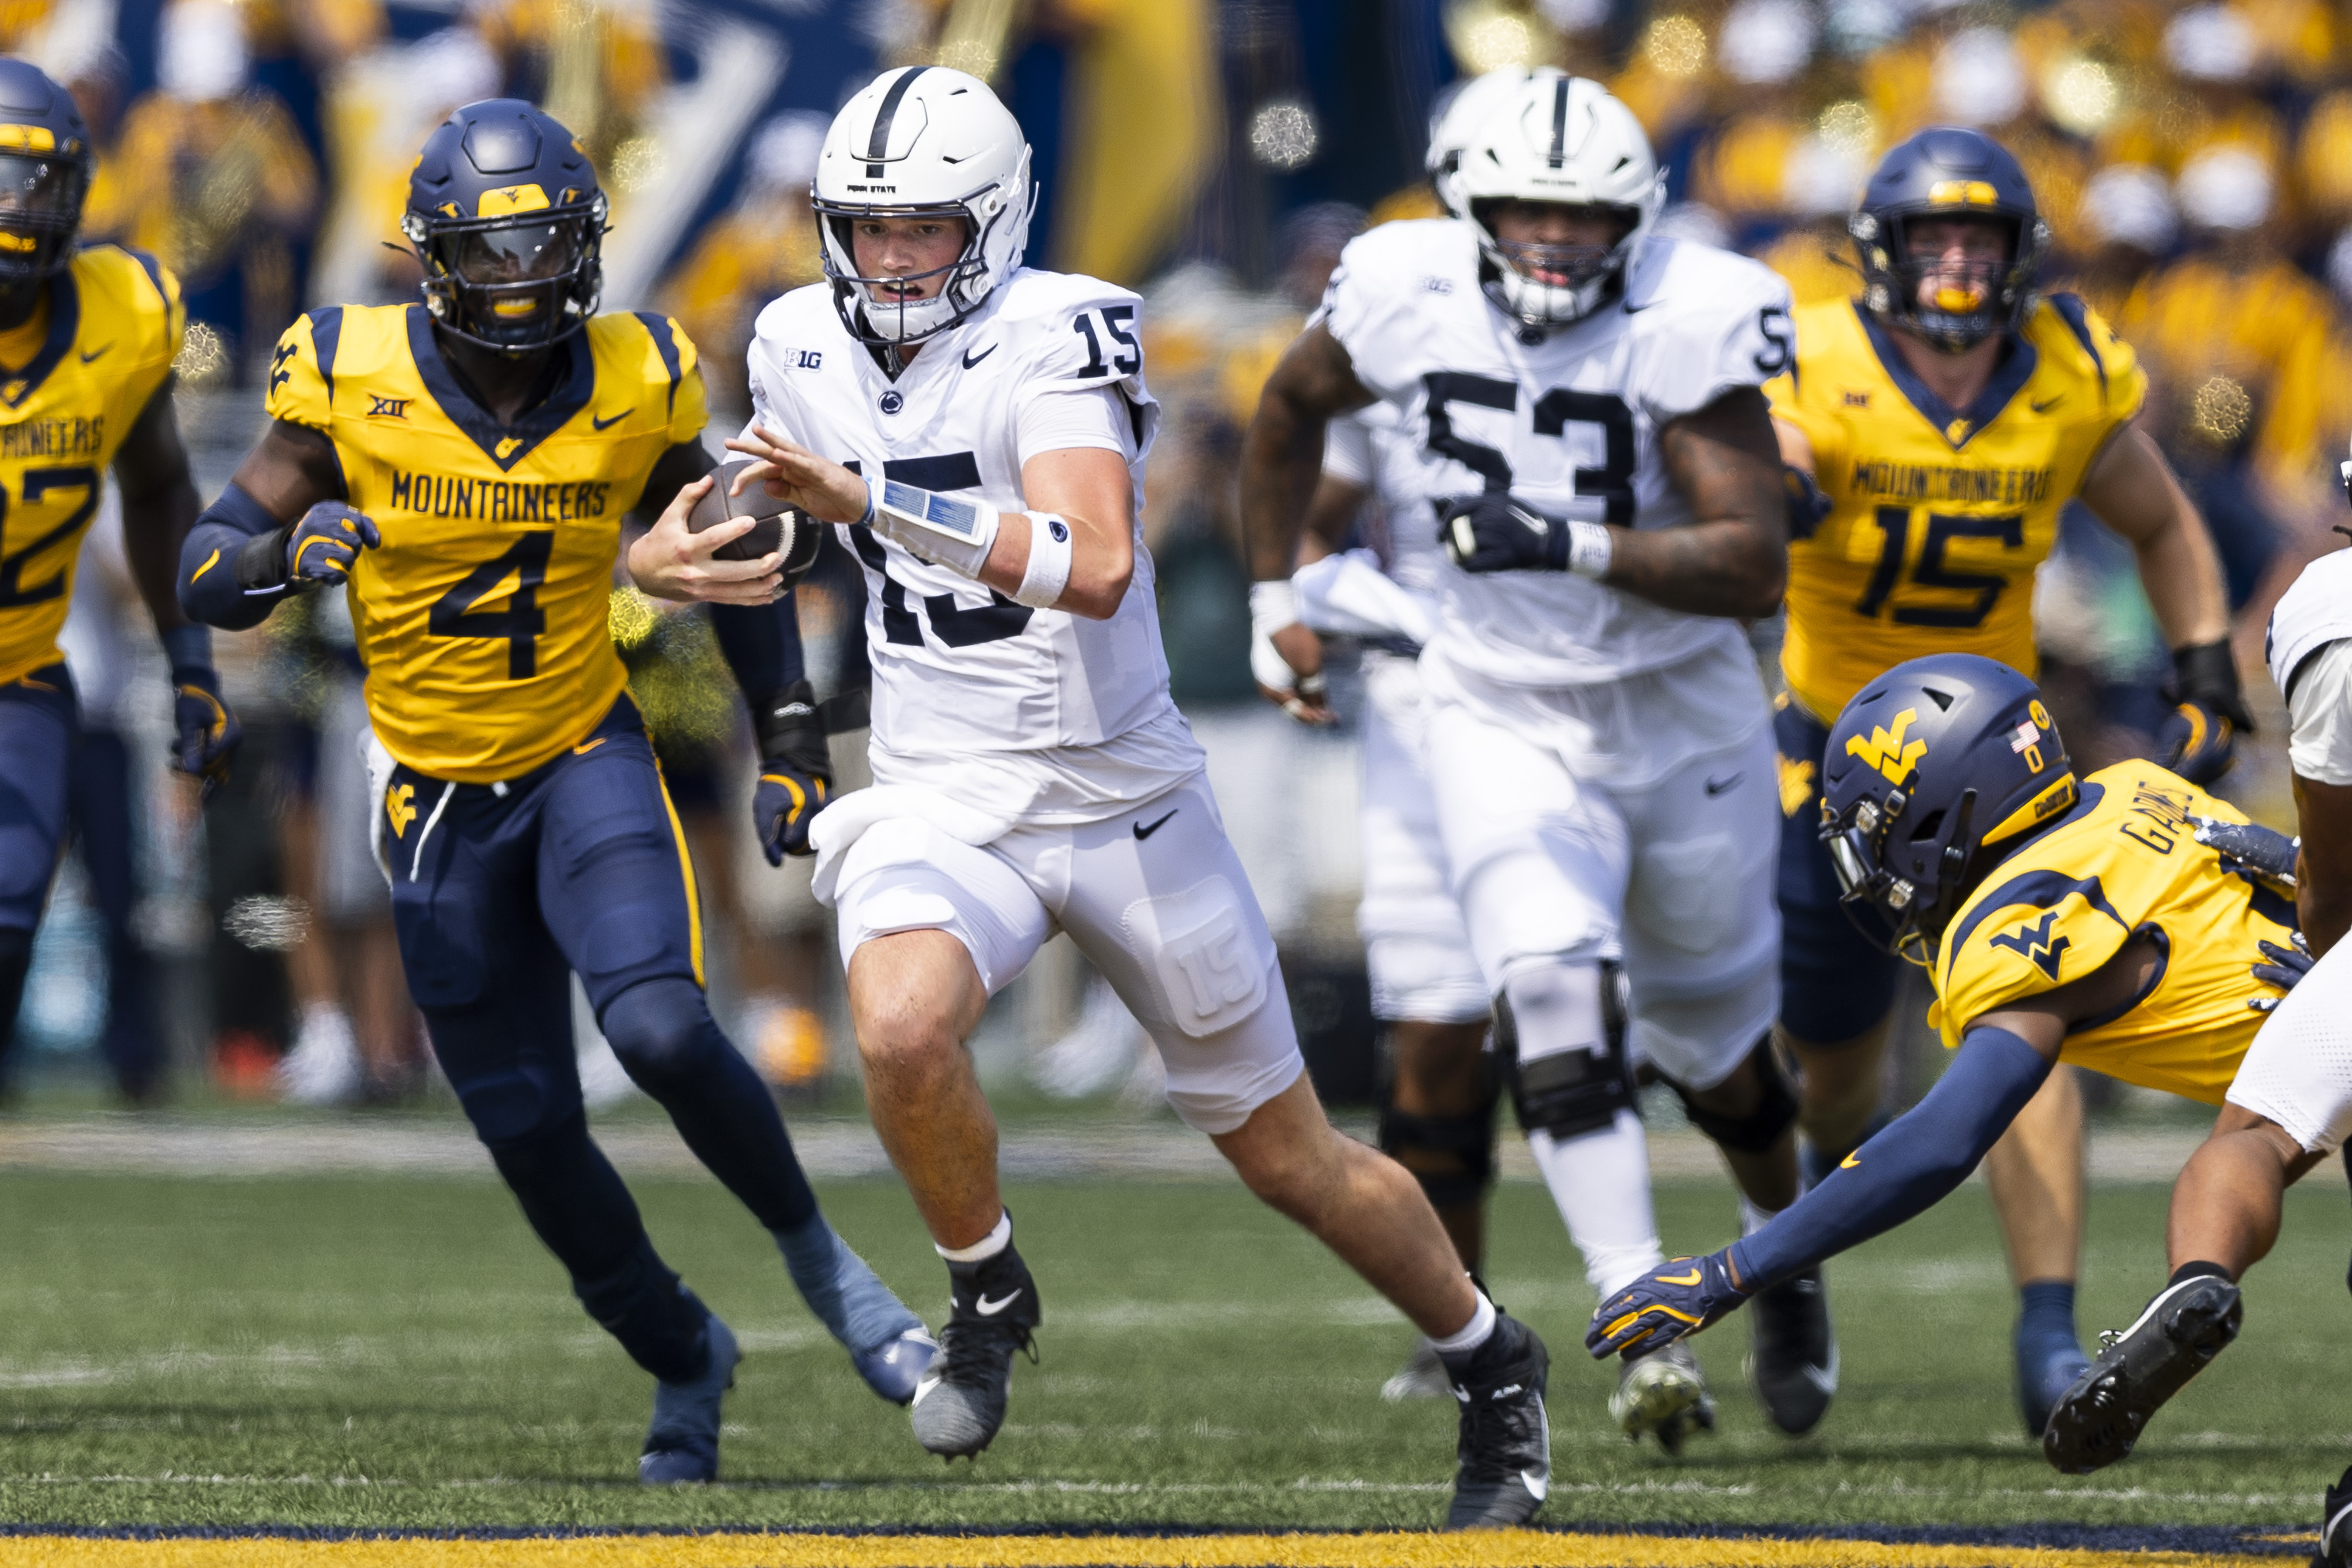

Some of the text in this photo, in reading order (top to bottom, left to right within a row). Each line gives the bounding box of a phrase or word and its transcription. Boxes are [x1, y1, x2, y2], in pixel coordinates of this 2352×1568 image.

[1073, 305, 1141, 378] 15
[392, 470, 611, 522] MOUNTAINEERS
[1420, 371, 1634, 533] 53
[0, 466, 100, 607] 2
[1855, 505, 2024, 627] 15
[429, 529, 555, 680] 4
[1177, 925, 1257, 1020] 15
